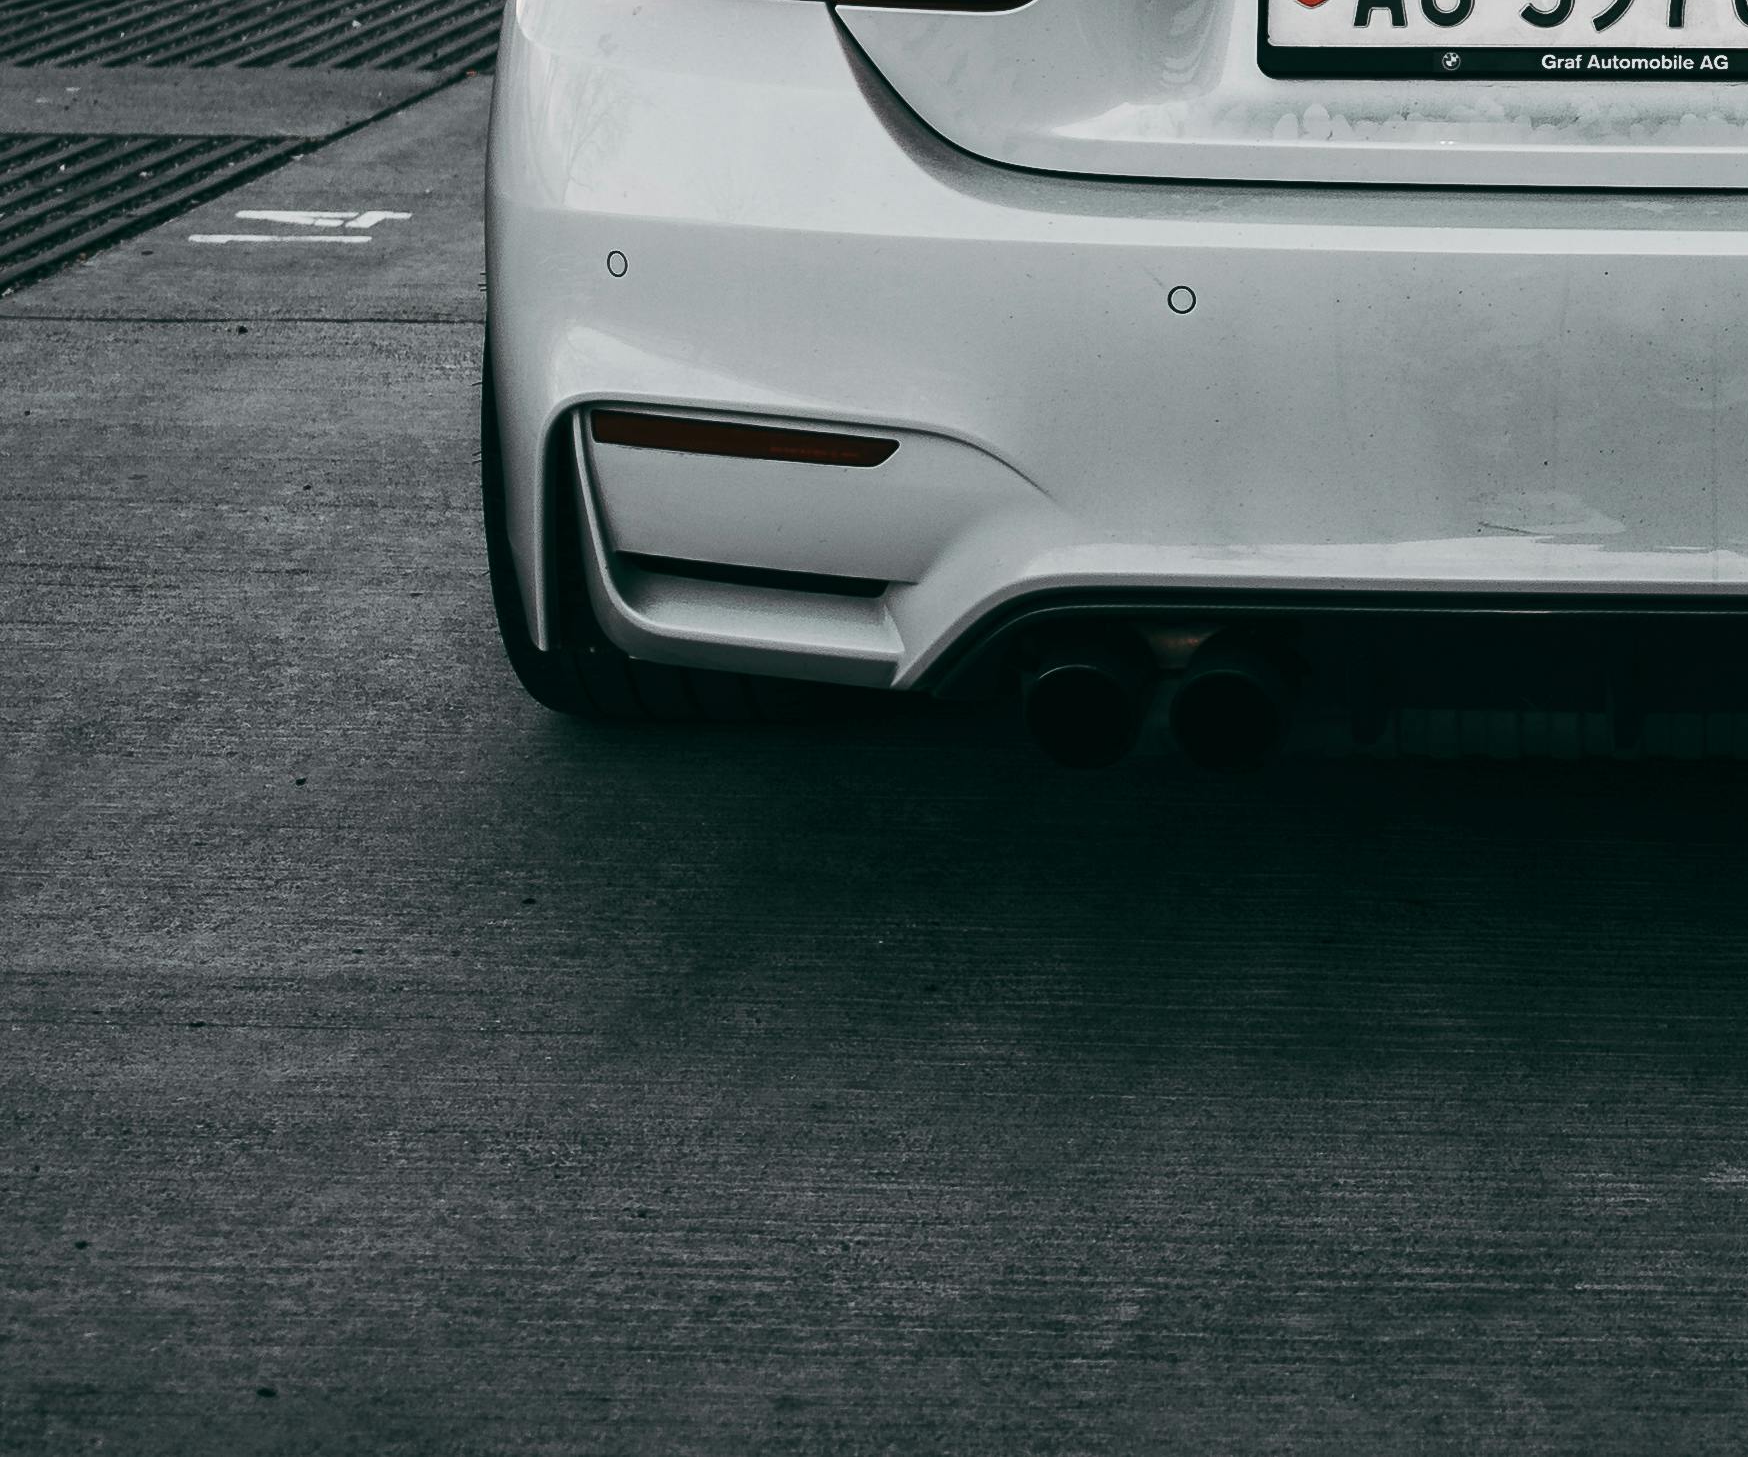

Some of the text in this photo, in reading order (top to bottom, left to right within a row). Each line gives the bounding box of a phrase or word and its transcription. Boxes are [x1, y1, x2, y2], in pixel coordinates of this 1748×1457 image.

[1541, 54, 1729, 71] Graf Automobile AG
